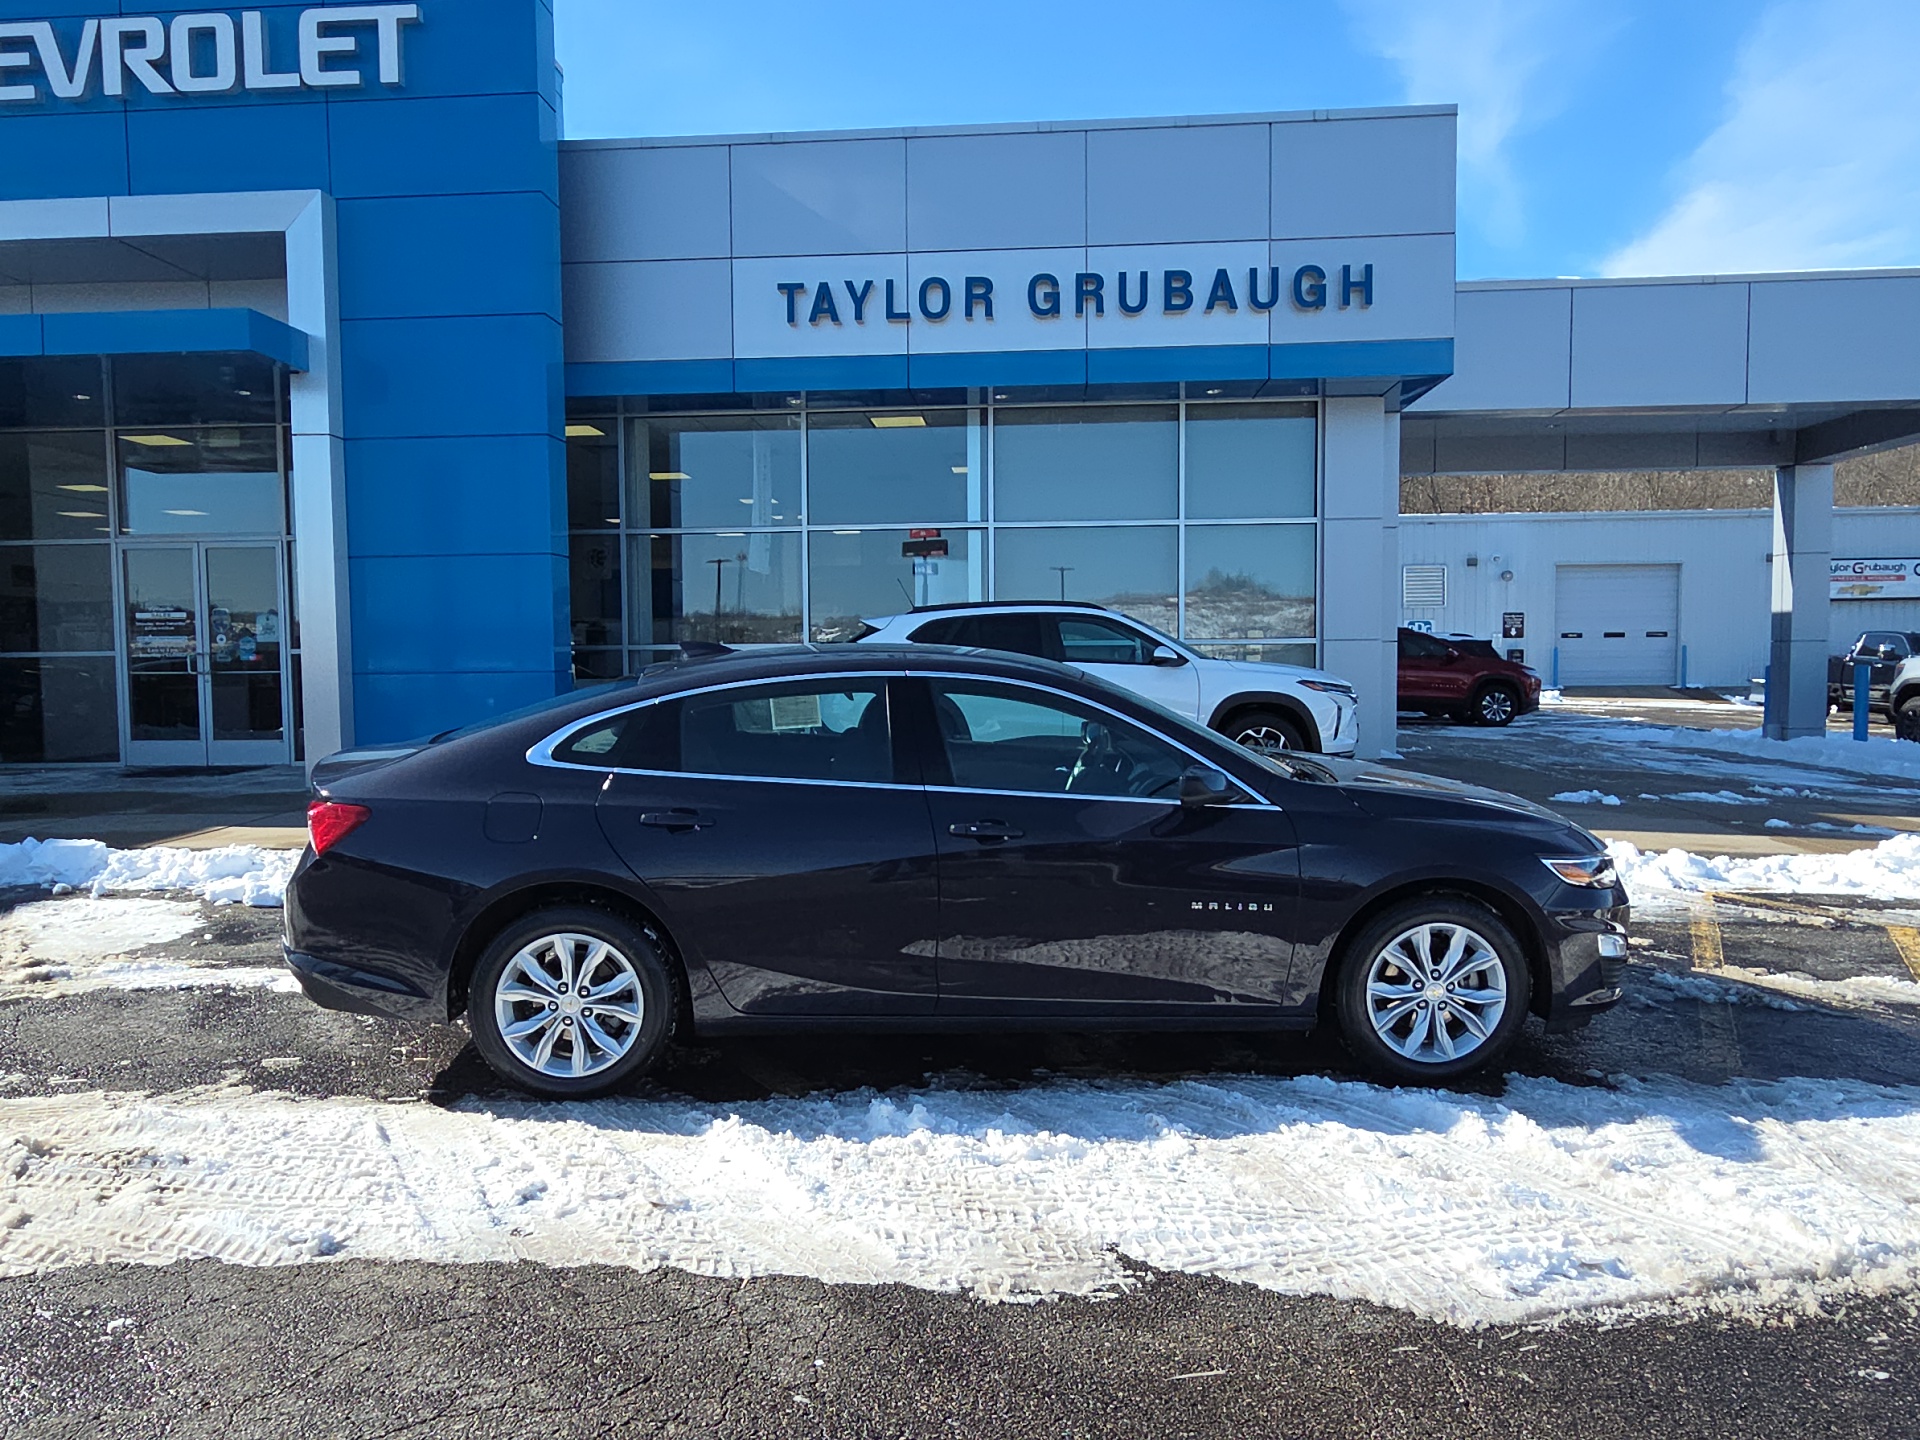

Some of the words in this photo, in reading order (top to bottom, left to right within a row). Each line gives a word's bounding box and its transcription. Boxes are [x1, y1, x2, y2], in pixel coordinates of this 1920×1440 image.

[777, 276, 994, 327] TAYLOR
[1027, 263, 1374, 319] GRUBAUGH
[1852, 562, 1907, 574] Grubaugh
[1191, 901, 1273, 911] MALIBU
